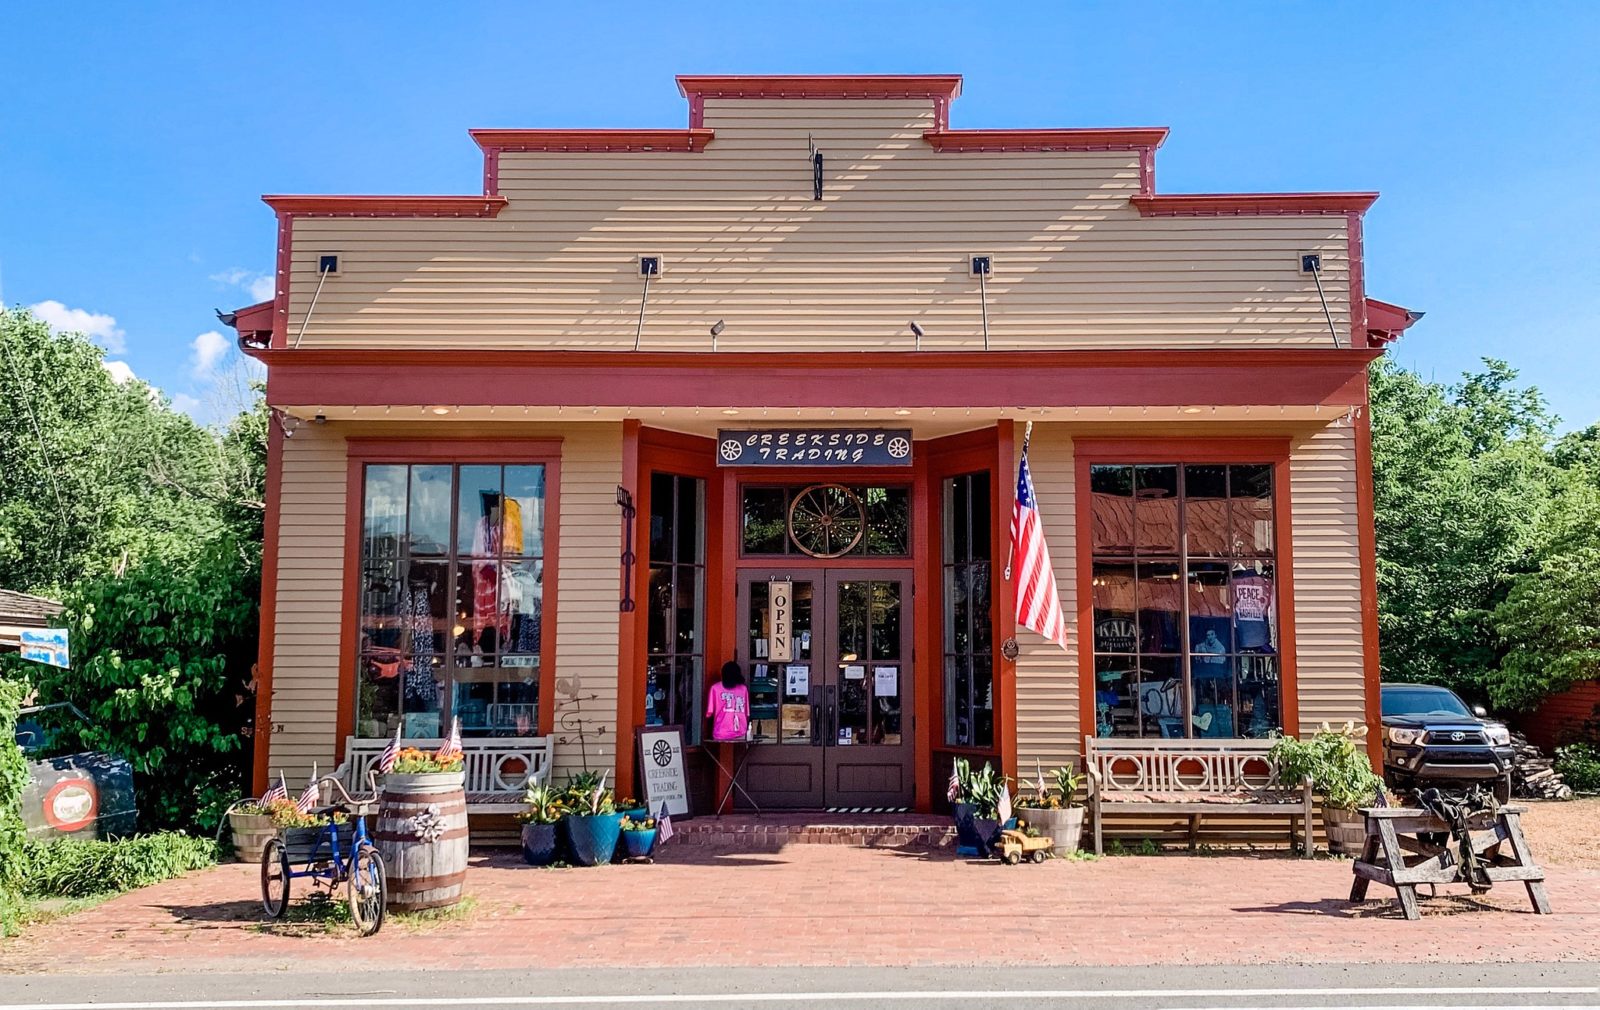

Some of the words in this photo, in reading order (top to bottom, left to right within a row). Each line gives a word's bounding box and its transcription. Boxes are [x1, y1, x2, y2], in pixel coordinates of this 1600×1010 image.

[746, 433, 885, 446] CREEKSIDE
[759, 447, 864, 463] TRADING
[1238, 588, 1260, 600] PEACE
[774, 595, 787, 649] OPEN
[1099, 621, 1137, 637] KALA
[652, 781, 678, 793] TRADING
